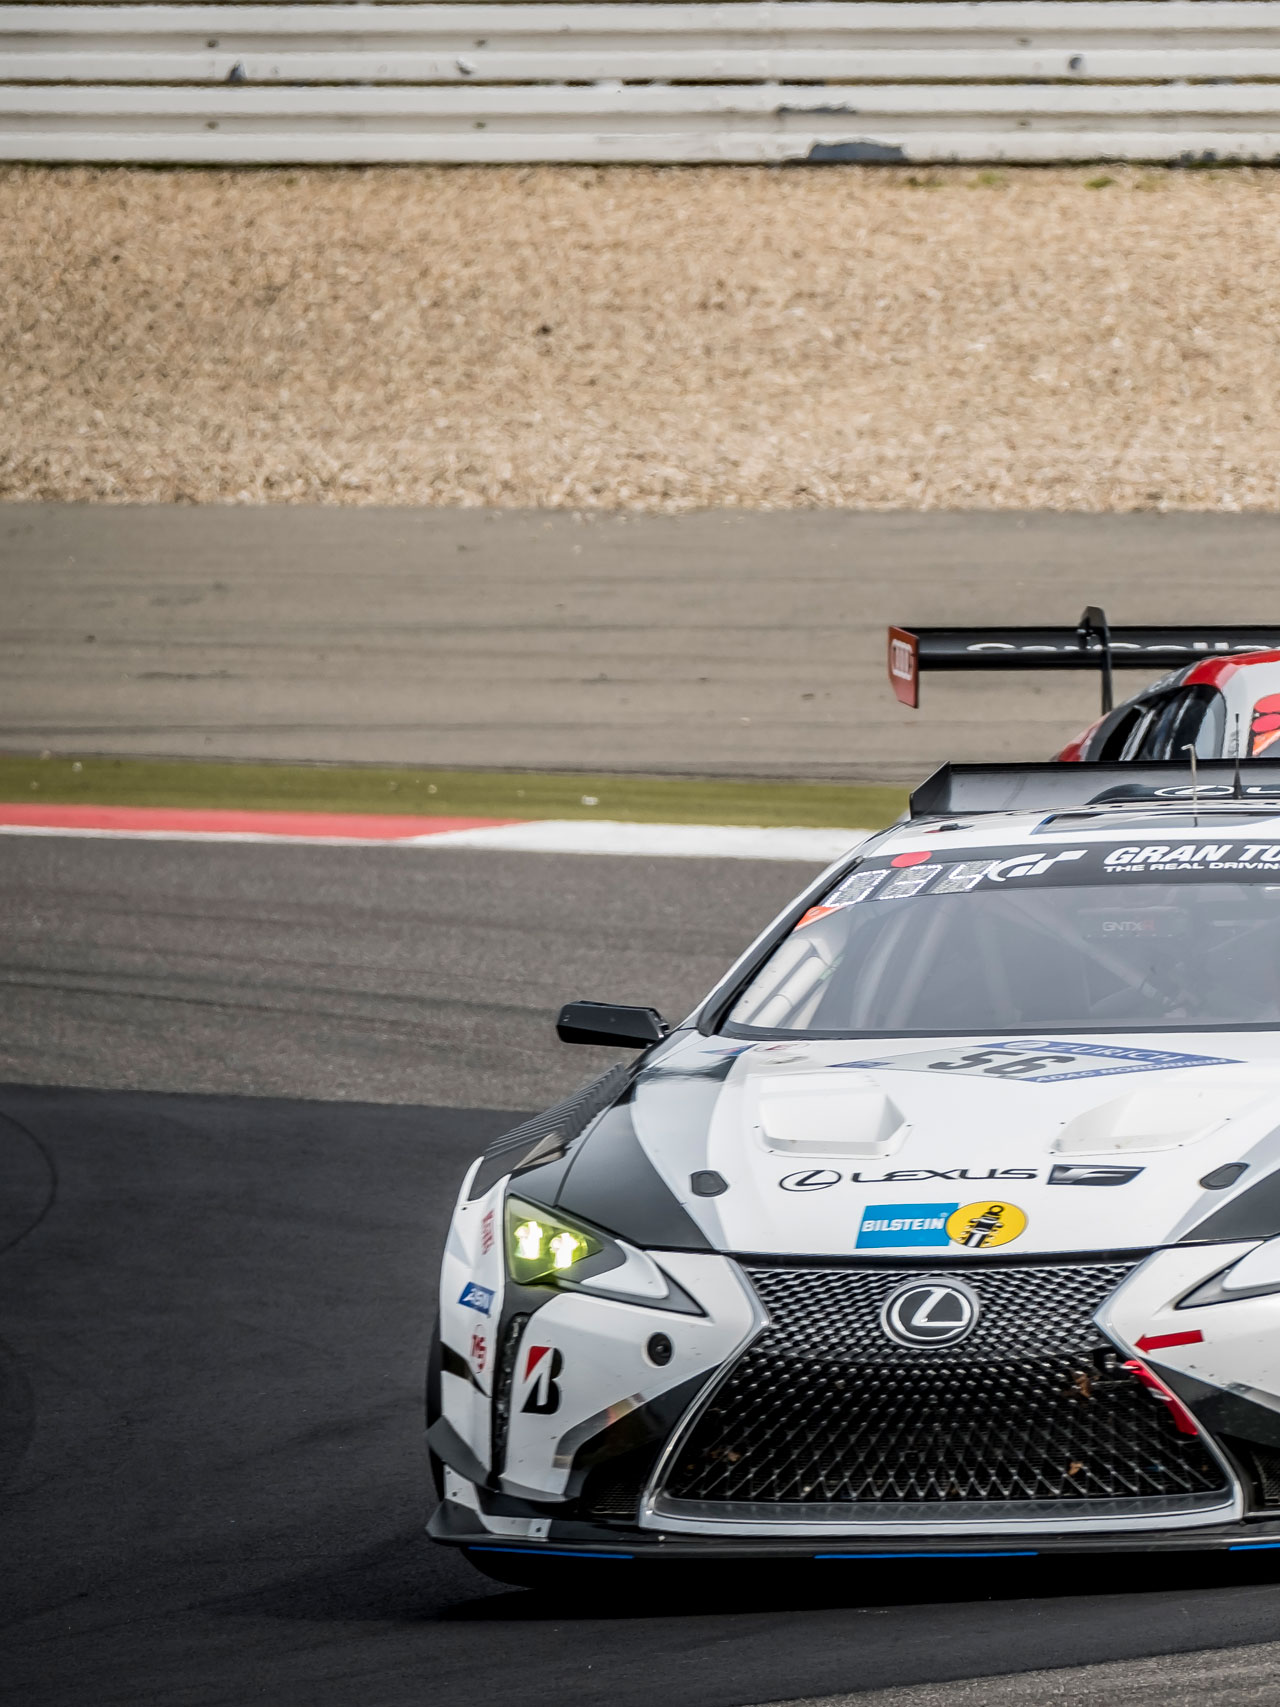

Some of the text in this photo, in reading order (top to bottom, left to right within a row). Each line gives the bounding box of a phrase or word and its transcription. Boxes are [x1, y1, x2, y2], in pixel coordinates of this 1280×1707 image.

[1103, 844, 1235, 866] GRAN
[1103, 865, 1146, 873] THE
[1149, 863, 1205, 872] REAL
[927, 1050, 1077, 1075] 56
[1042, 1044, 1186, 1063] ZURICH
[1034, 1058, 1228, 1083] ADAC NORDRHEIN
[851, 1168, 1039, 1183] LEXUS
[860, 1215, 946, 1234] BILSTEIN
